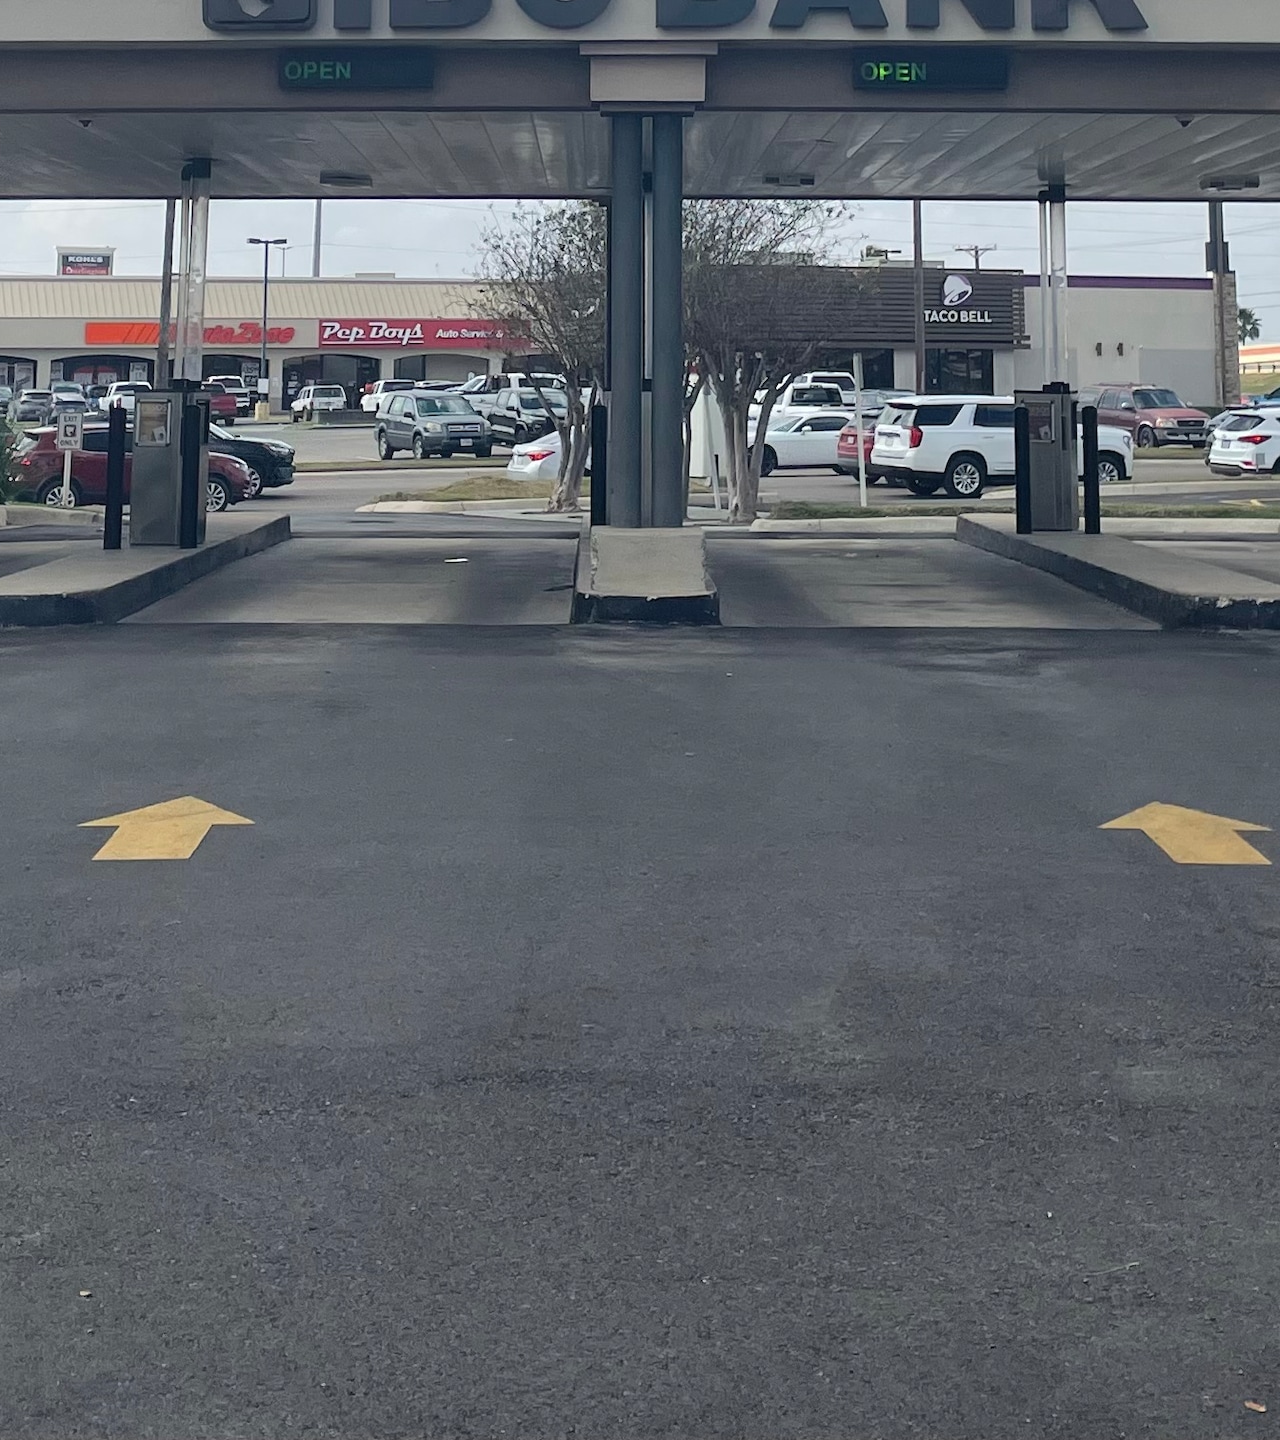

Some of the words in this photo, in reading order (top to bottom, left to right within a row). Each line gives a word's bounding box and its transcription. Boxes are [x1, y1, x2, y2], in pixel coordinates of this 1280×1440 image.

[284, 62, 353, 81] OPEN
[860, 61, 927, 82] OPEN
[923, 310, 958, 322] TACO
[960, 310, 992, 322] BELL
[322, 322, 365, 342] Pep
[369, 322, 424, 345] Boys
[435, 328, 458, 339] Auto
[60, 439, 78, 447] ONLY
